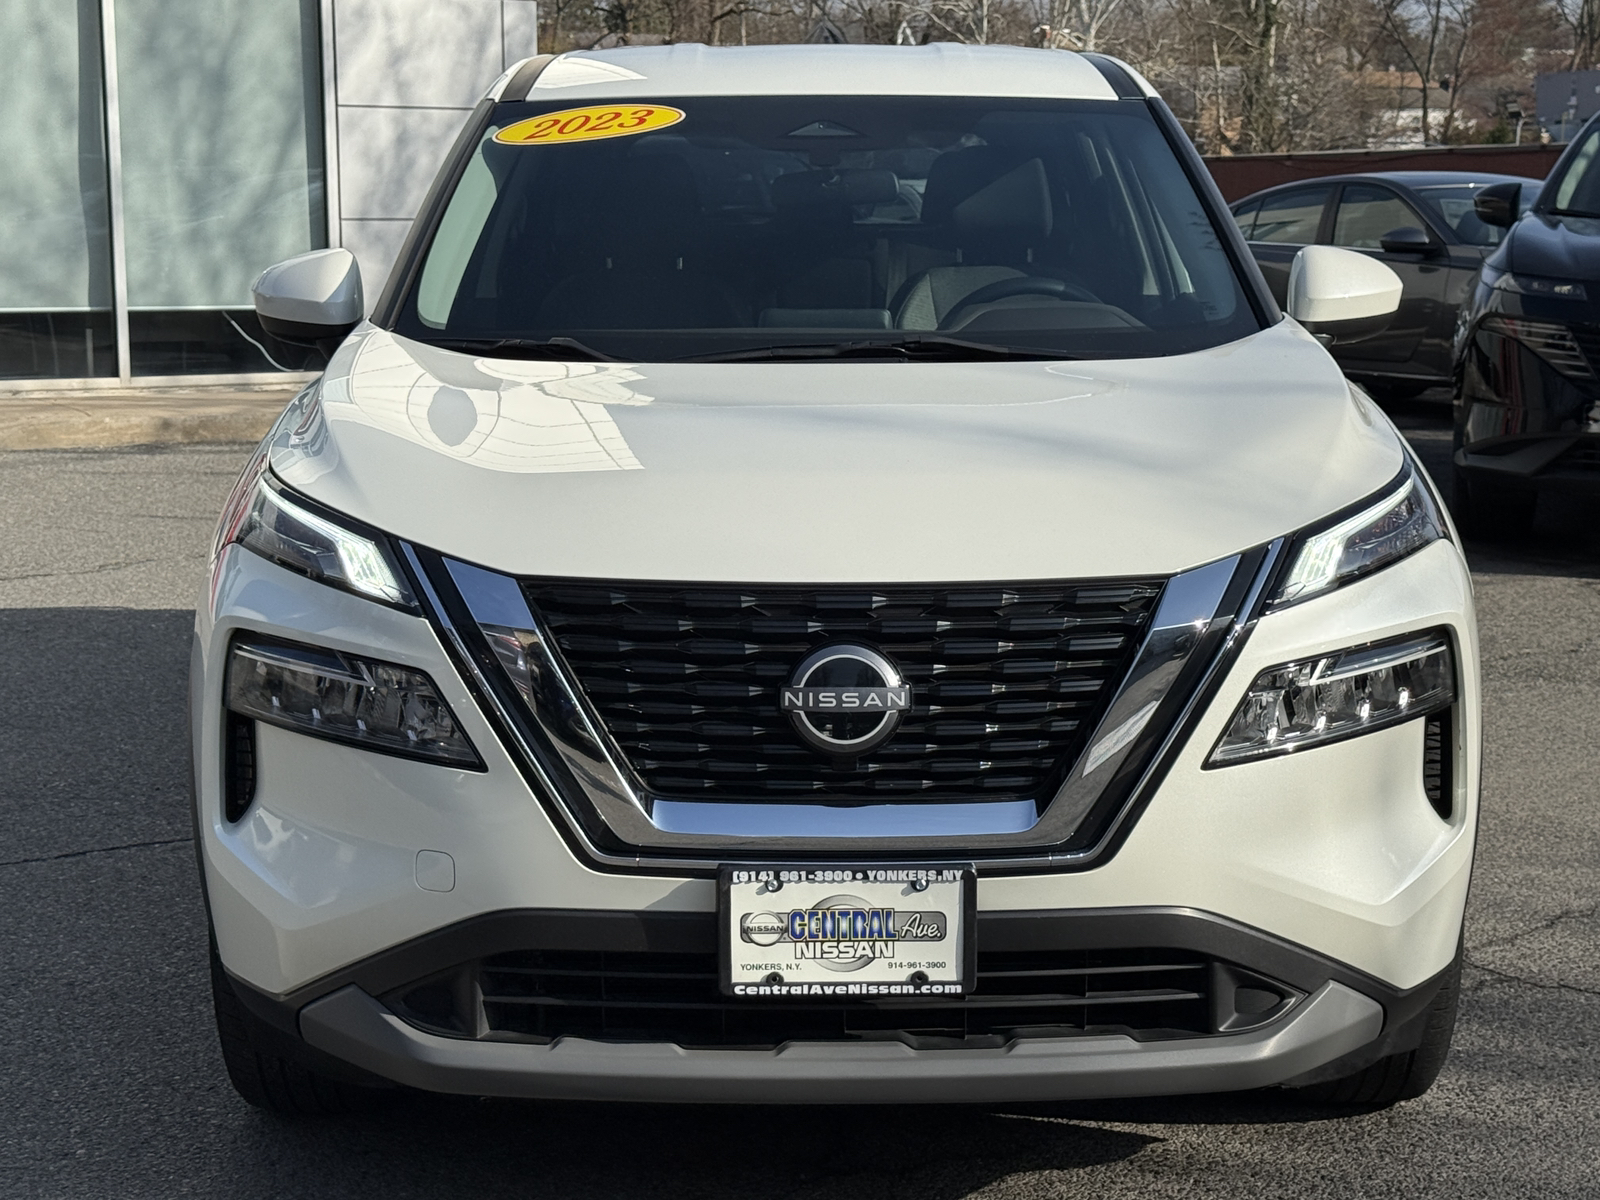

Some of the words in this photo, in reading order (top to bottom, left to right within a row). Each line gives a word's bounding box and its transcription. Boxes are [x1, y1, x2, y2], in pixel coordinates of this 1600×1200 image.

[523, 109, 655, 140] 2023
[784, 691, 905, 707] NISSAN
[779, 870, 853, 882] 961-3900
[788, 908, 899, 941] CENTRAL
[794, 941, 895, 959] NISSAN
[740, 963, 785, 971] YONKERS,
[785, 962, 802, 971] N.Y.
[887, 961, 947, 969] 914-961-3900
[734, 984, 963, 995] CentralAveNissan.com
